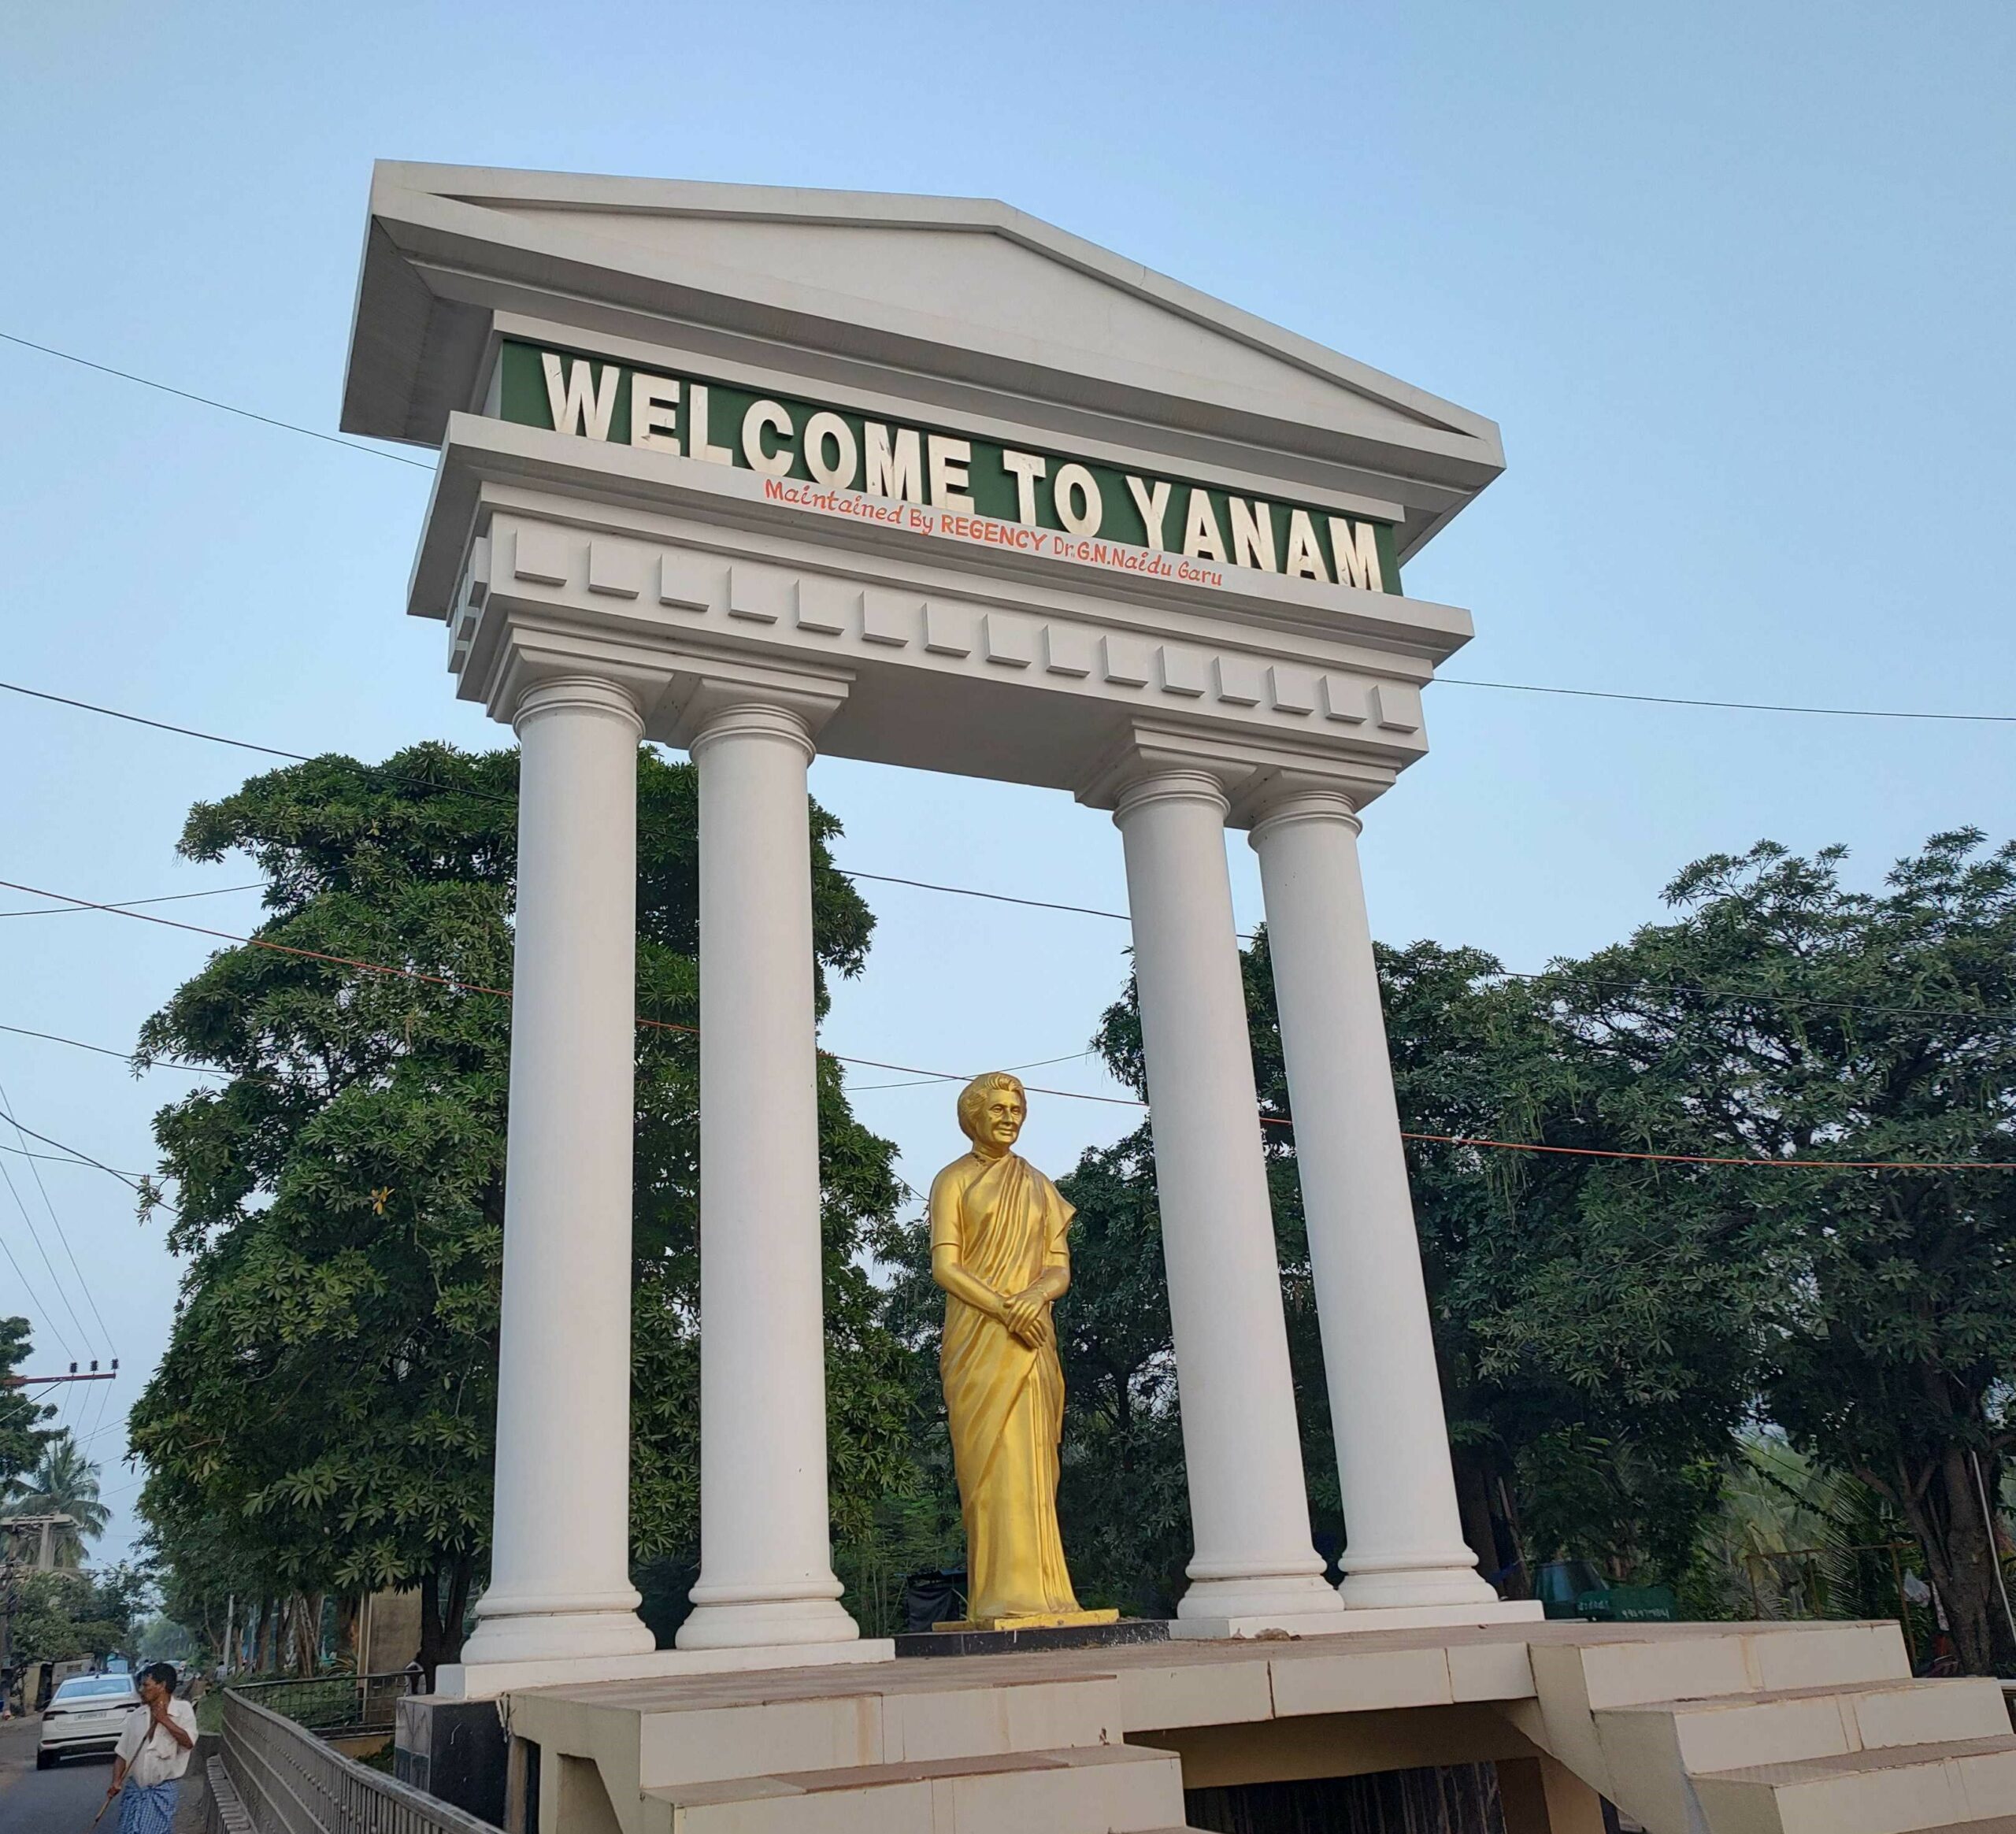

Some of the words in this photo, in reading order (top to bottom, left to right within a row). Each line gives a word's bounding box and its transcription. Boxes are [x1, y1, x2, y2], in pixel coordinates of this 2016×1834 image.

[541, 352, 975, 515] WELCOME
[1002, 448, 1102, 538] TO
[1125, 475, 1384, 593] YANAM
[764, 479, 905, 524] Maintained
[910, 508, 935, 536] By
[940, 513, 1047, 551] REGENCY
[1177, 560, 1223, 587] Garu
